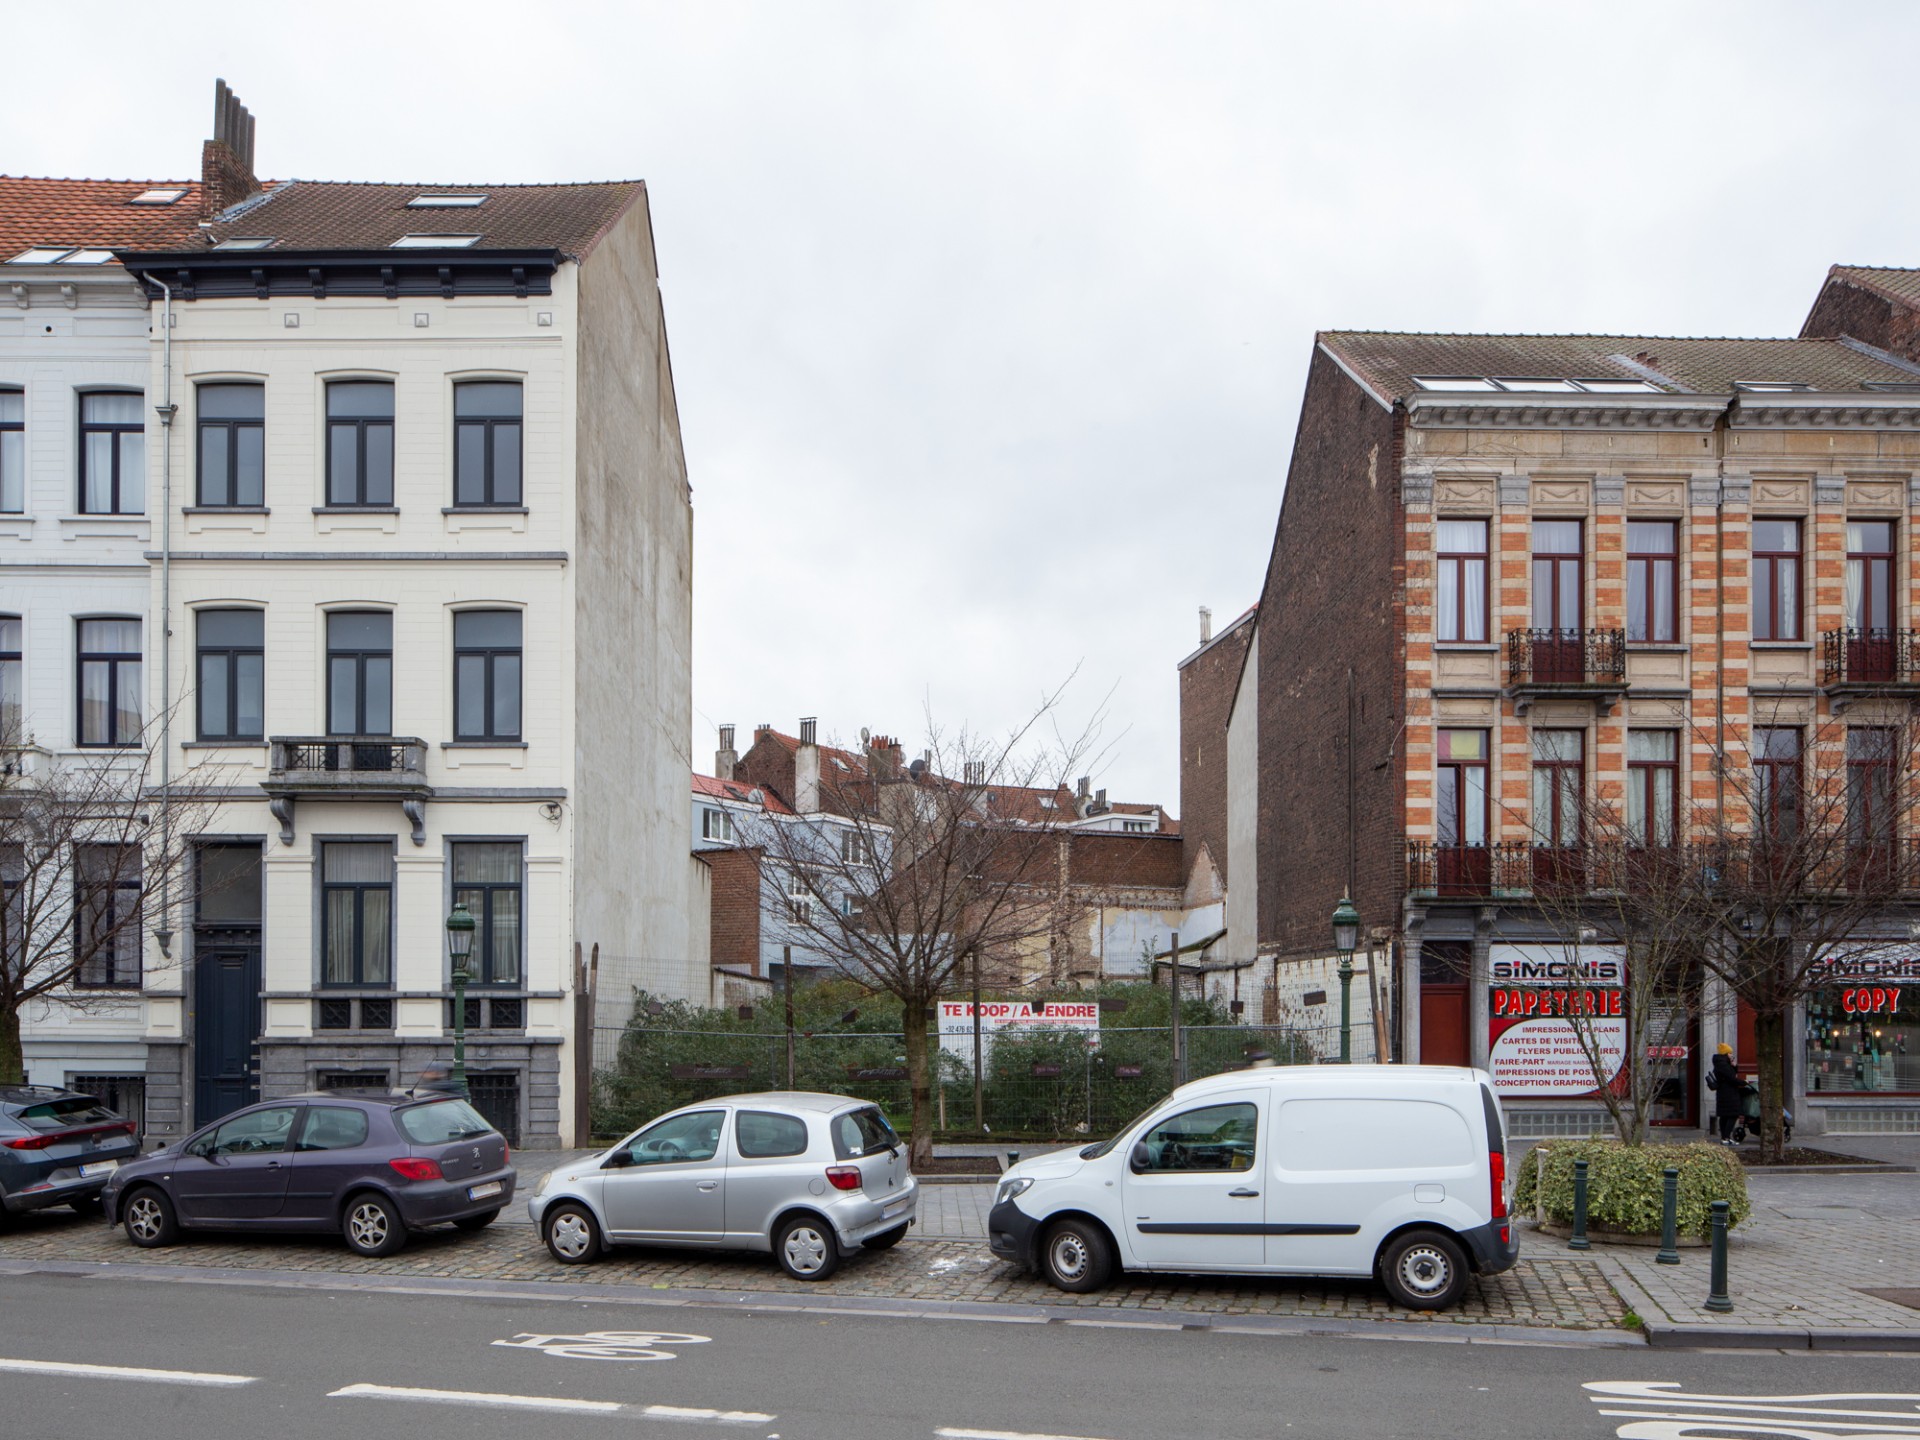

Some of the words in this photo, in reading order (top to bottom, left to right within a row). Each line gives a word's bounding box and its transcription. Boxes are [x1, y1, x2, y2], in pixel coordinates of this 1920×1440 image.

[1494, 989, 1622, 1015] PAPETERIE
[1842, 987, 1901, 1013] COPY
[943, 1004, 962, 1017] TE
[966, 1004, 1010, 1017] KOOP
[1012, 1004, 1018, 1018] /
[1020, 1004, 1031, 1017] A
[1502, 1037, 1537, 1045] CARTES
[1540, 1037, 1551, 1045] DE
[1517, 1047, 1551, 1055] FLYERS
[1553, 1047, 1620, 1055] PUBLICTIRES
[1494, 1058, 1545, 1066] FAIRE-PART
[1495, 1068, 1556, 1076] IMPRESSIONS
[1559, 1068, 1570, 1076] DE
[1572, 1068, 1613, 1076] POSRS
[1494, 1079, 1551, 1087] CONCEPTION
[1553, 1079, 1600, 1087] GRAPHIQU
